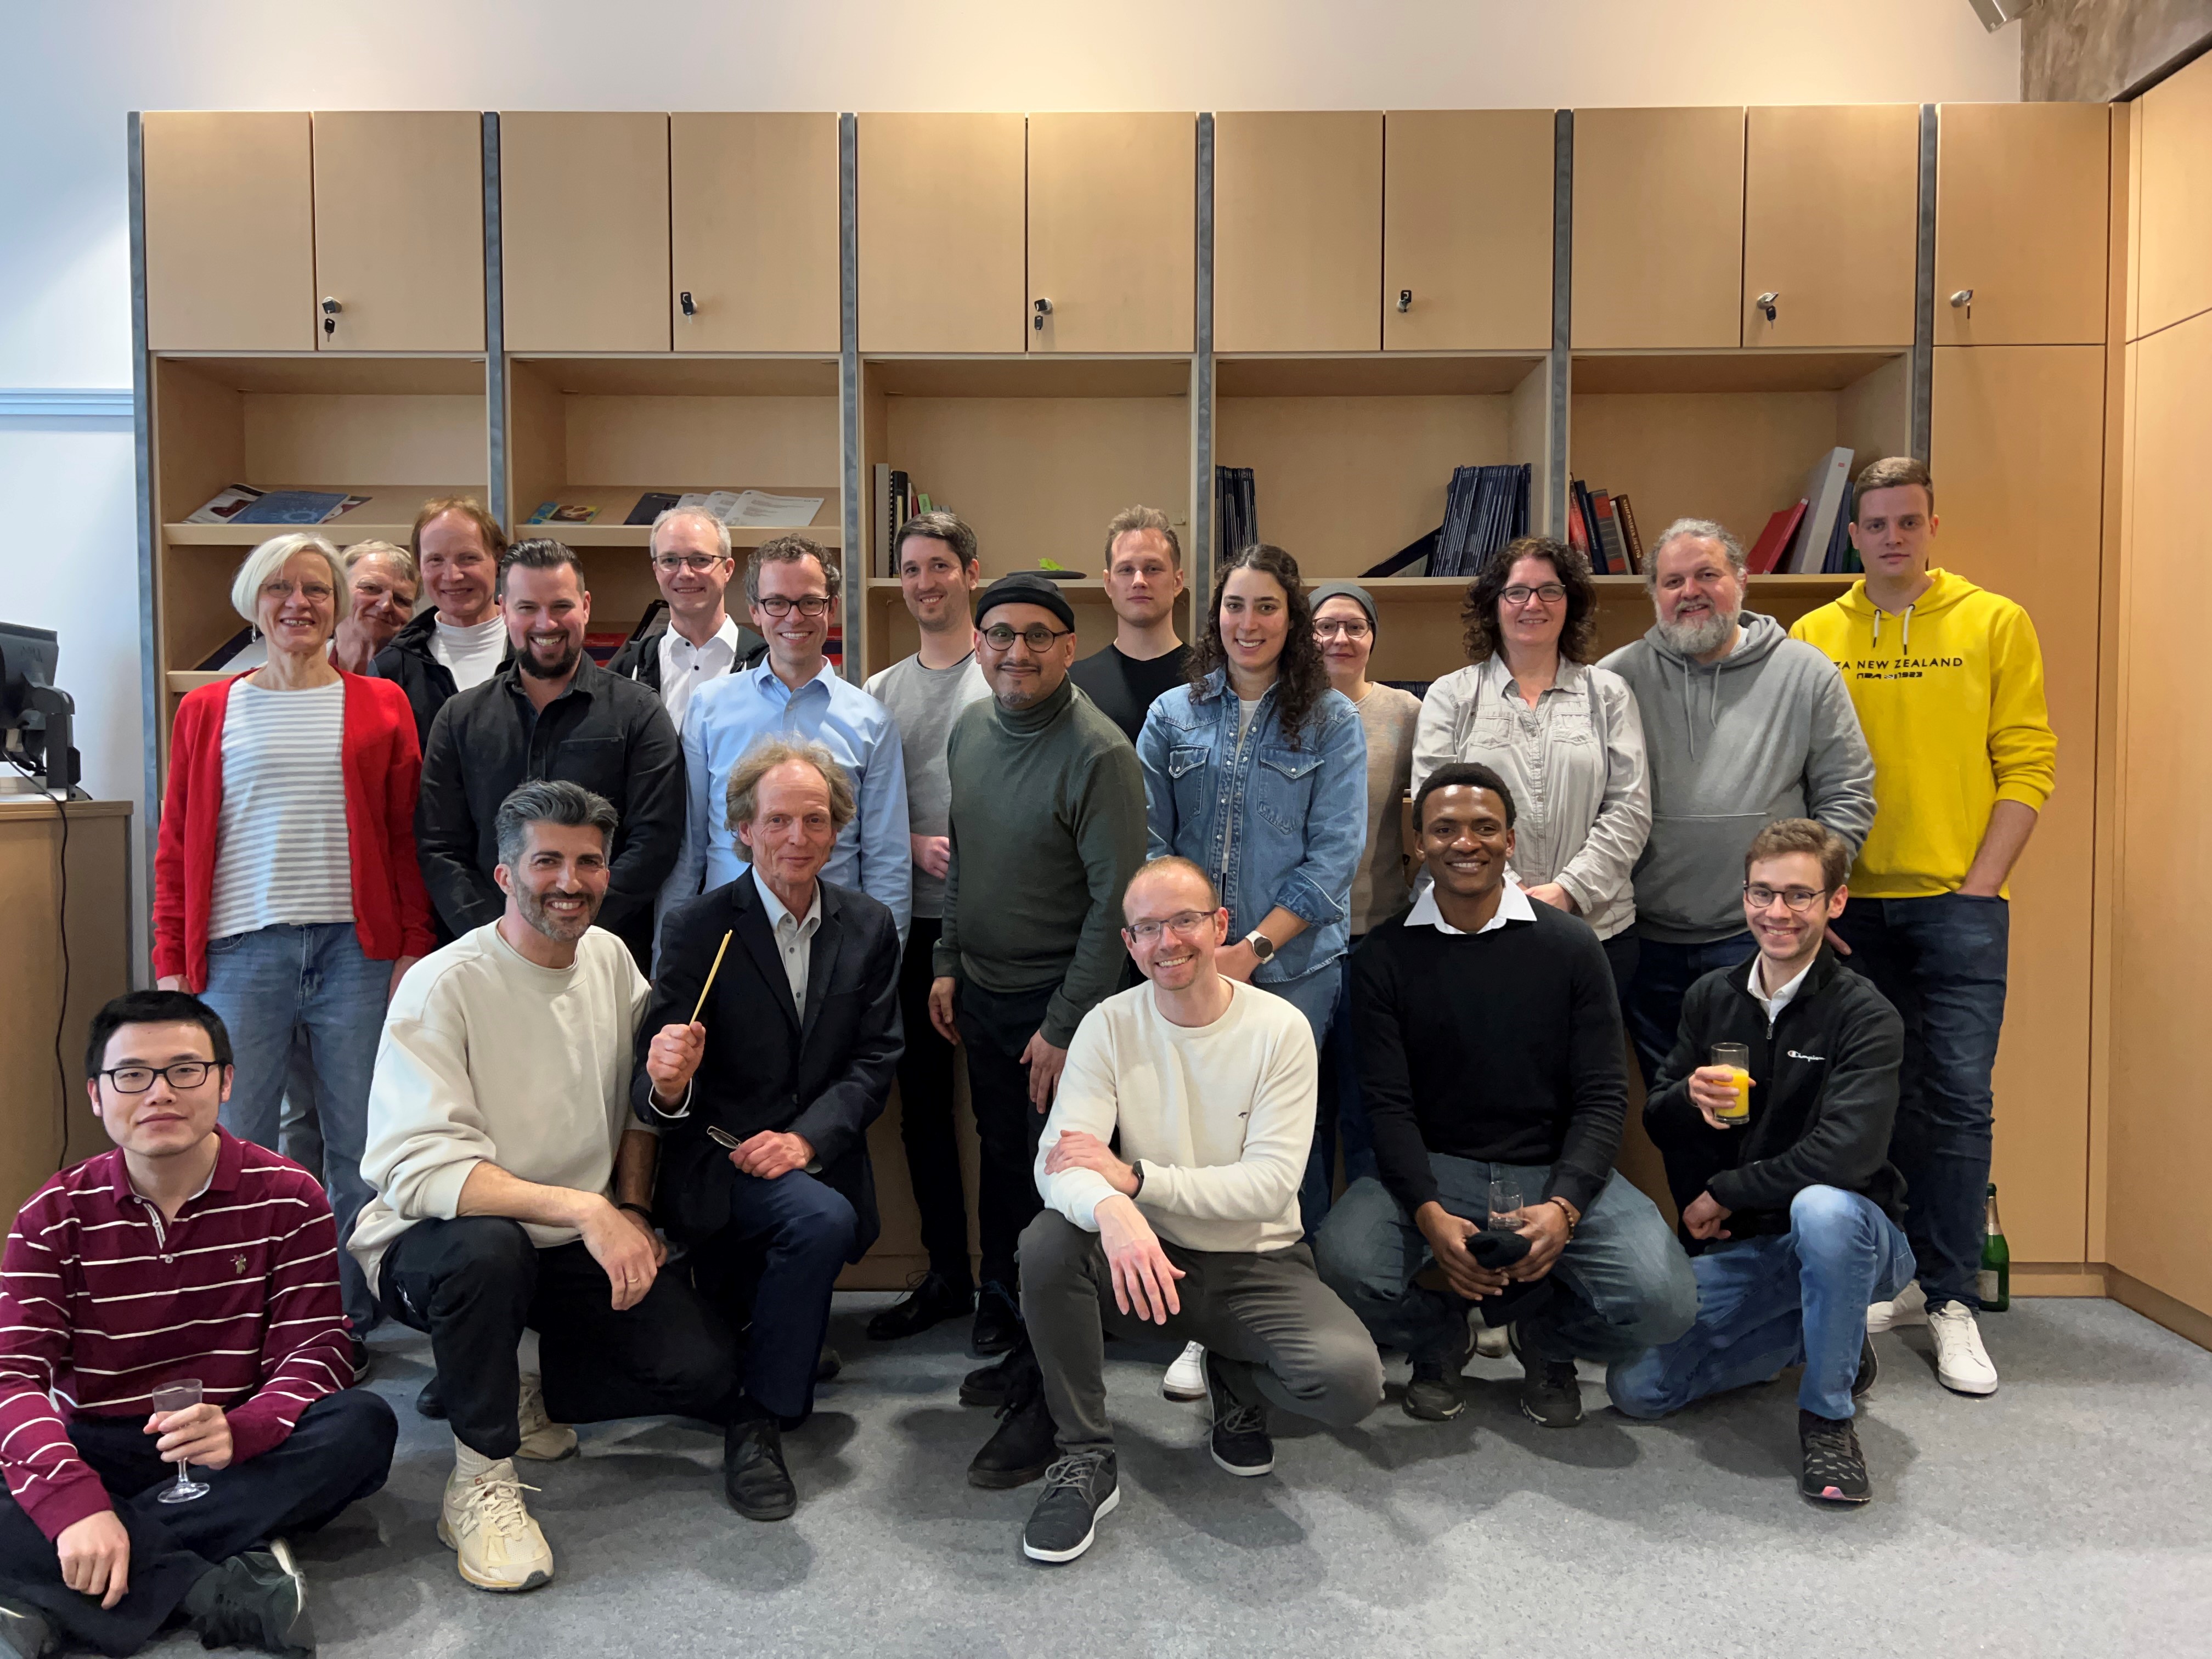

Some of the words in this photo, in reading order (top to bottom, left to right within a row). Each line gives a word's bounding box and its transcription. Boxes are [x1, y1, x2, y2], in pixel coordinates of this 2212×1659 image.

[1833, 661, 1850, 670] ZA
[1857, 660, 1889, 669] NEW
[1894, 658, 1963, 669] ZEALAND
